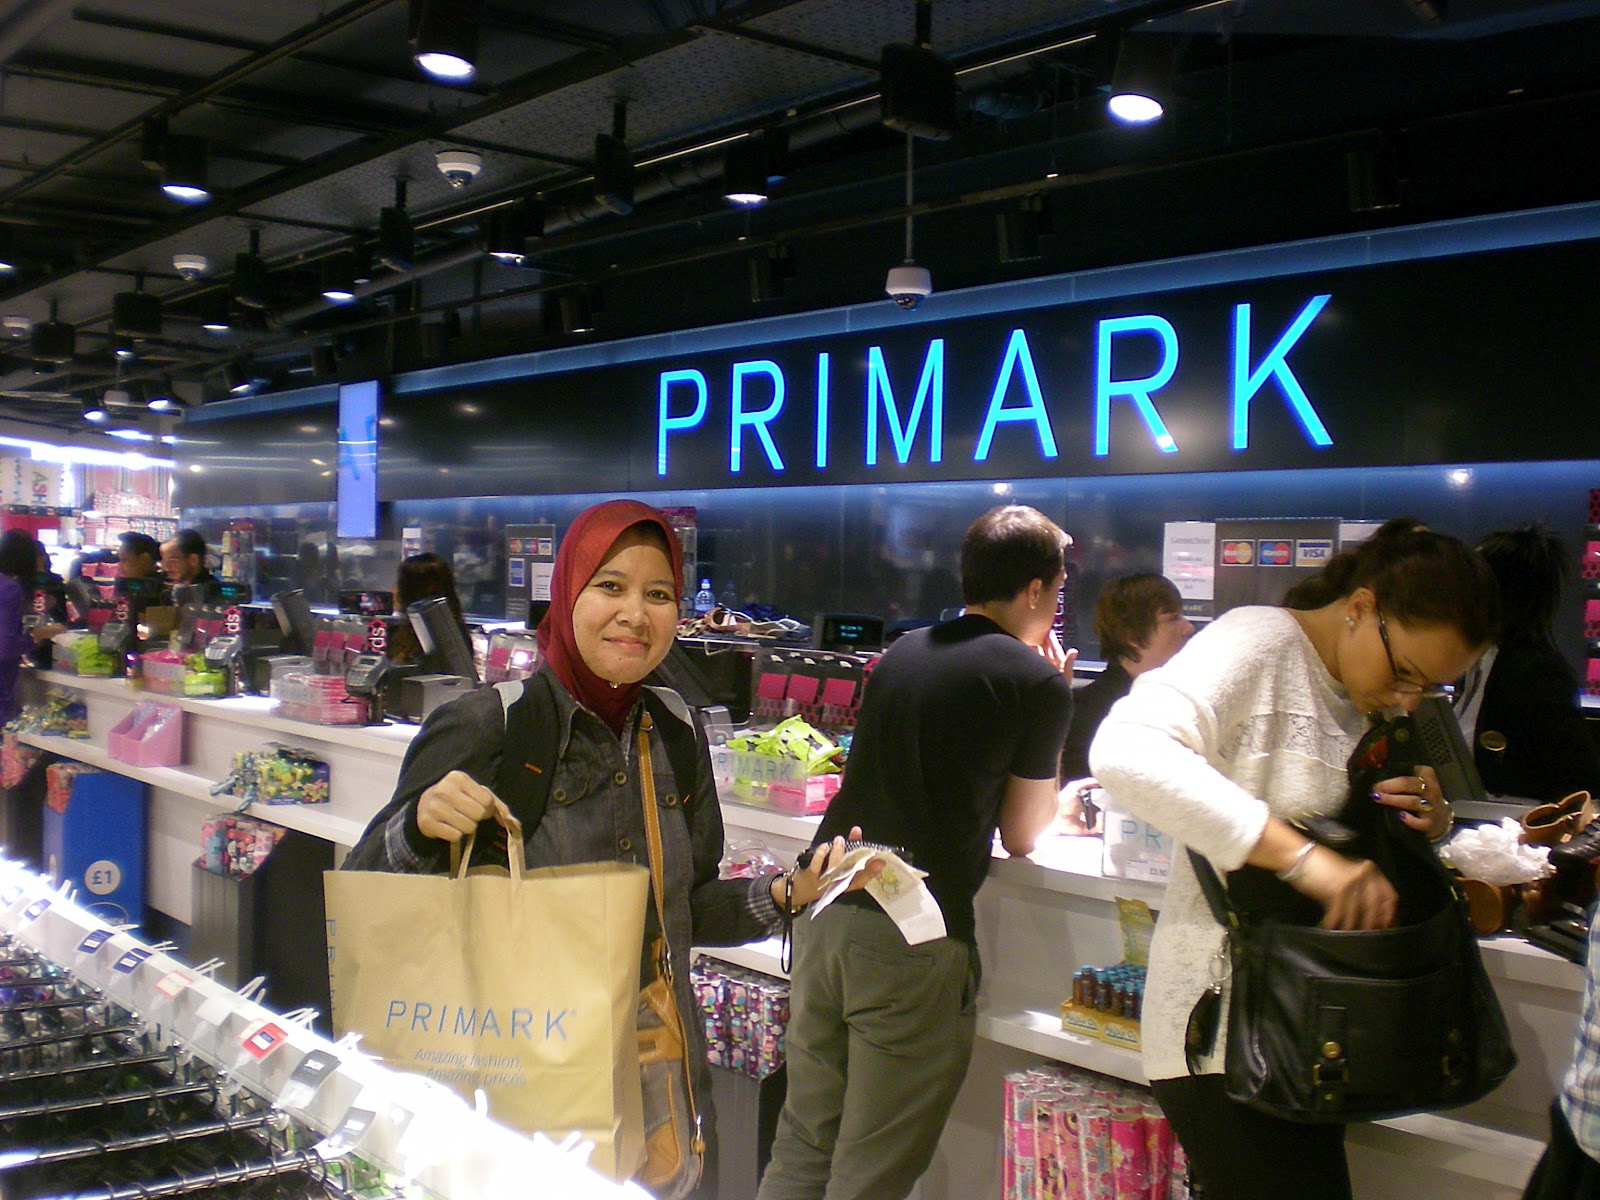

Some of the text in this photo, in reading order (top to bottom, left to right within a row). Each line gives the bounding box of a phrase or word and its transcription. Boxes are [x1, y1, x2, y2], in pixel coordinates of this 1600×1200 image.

[658, 294, 1334, 475] PRIMARK
[1303, 548, 1326, 558] VISA
[711, 751, 793, 784] RIMARK
[91, 870, 112, 885] £1
[386, 1000, 568, 1041] PRIMARK
